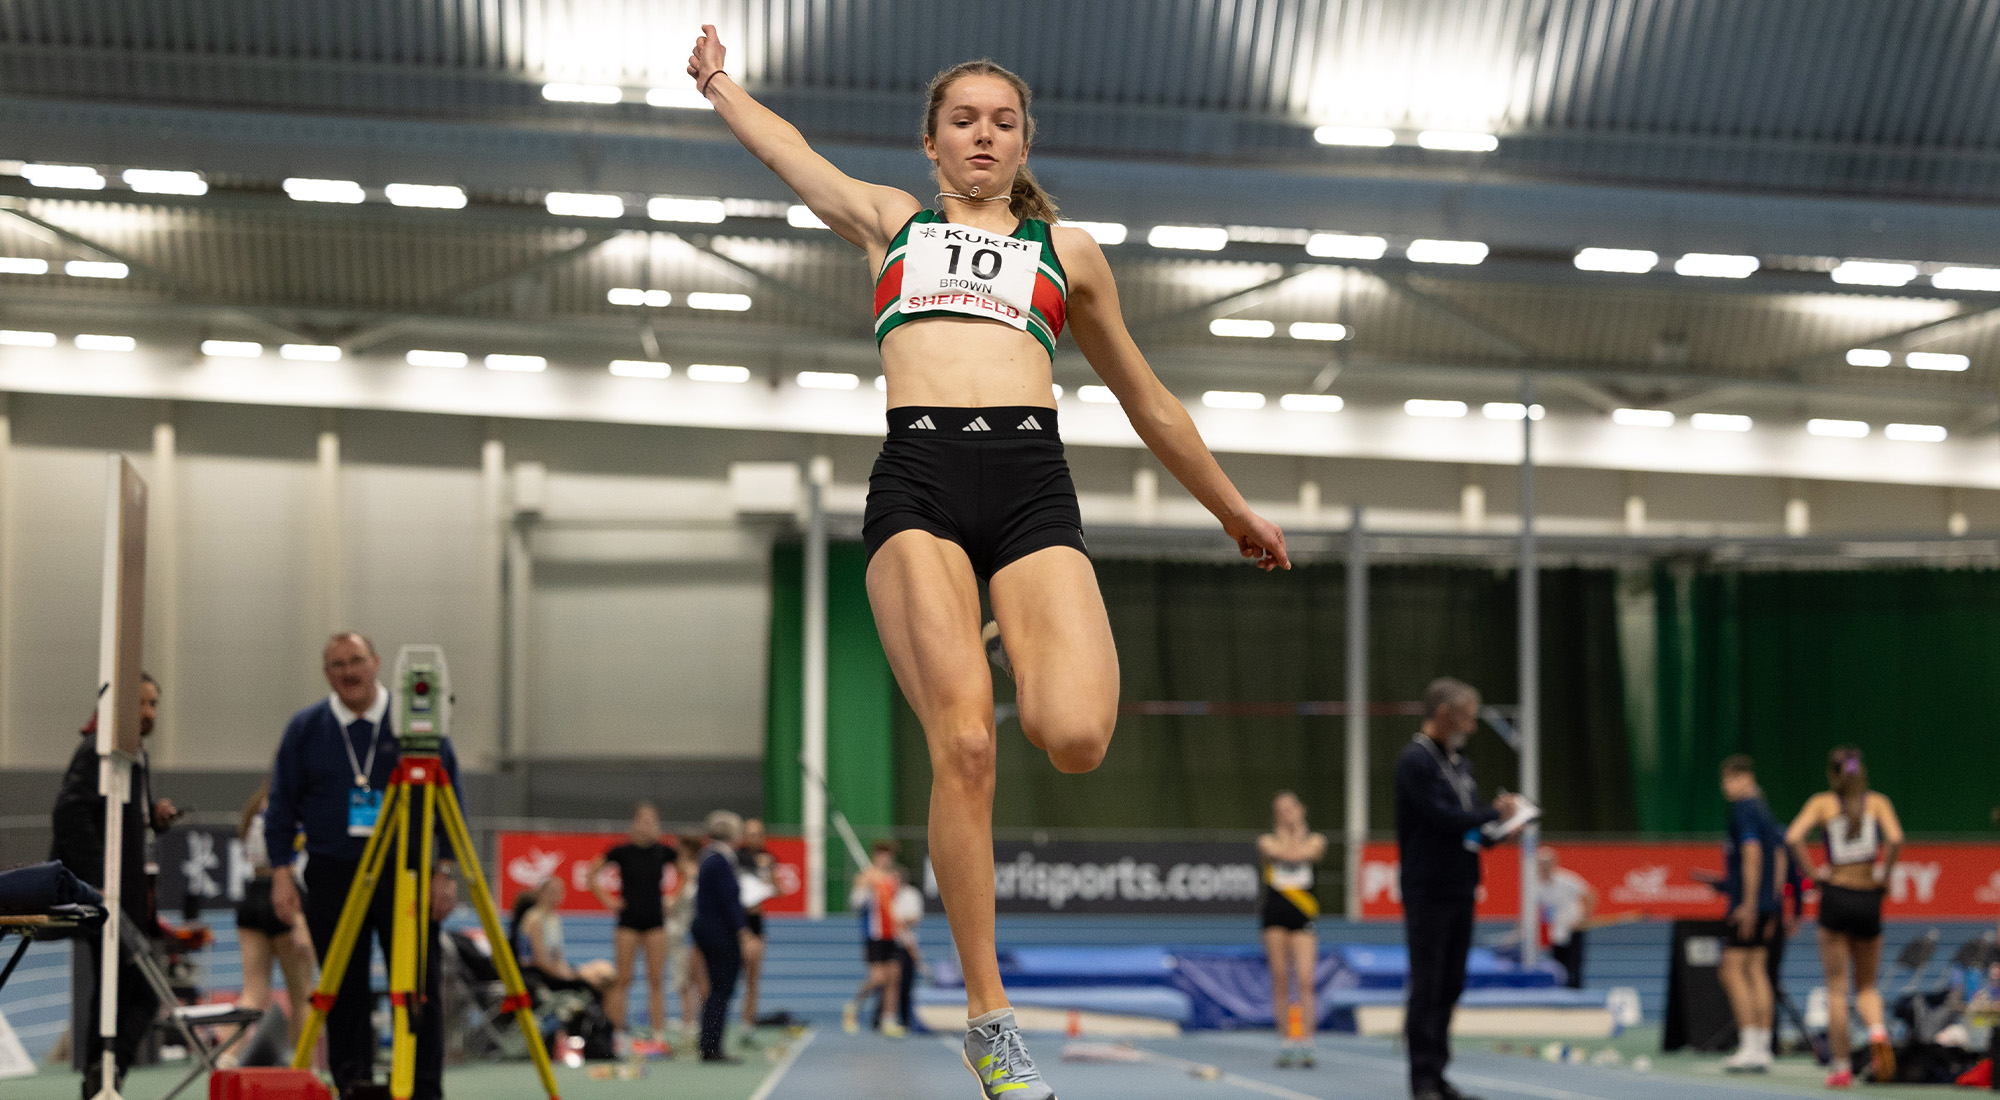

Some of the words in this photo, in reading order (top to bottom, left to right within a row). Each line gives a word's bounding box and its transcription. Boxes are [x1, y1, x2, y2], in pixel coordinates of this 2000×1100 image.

[944, 229, 1028, 251] KUKRI
[945, 244, 1003, 281] 10
[939, 278, 993, 294] BROWN
[908, 294, 1020, 319] SHEFFIELD
[923, 852, 1259, 909] risports.com
